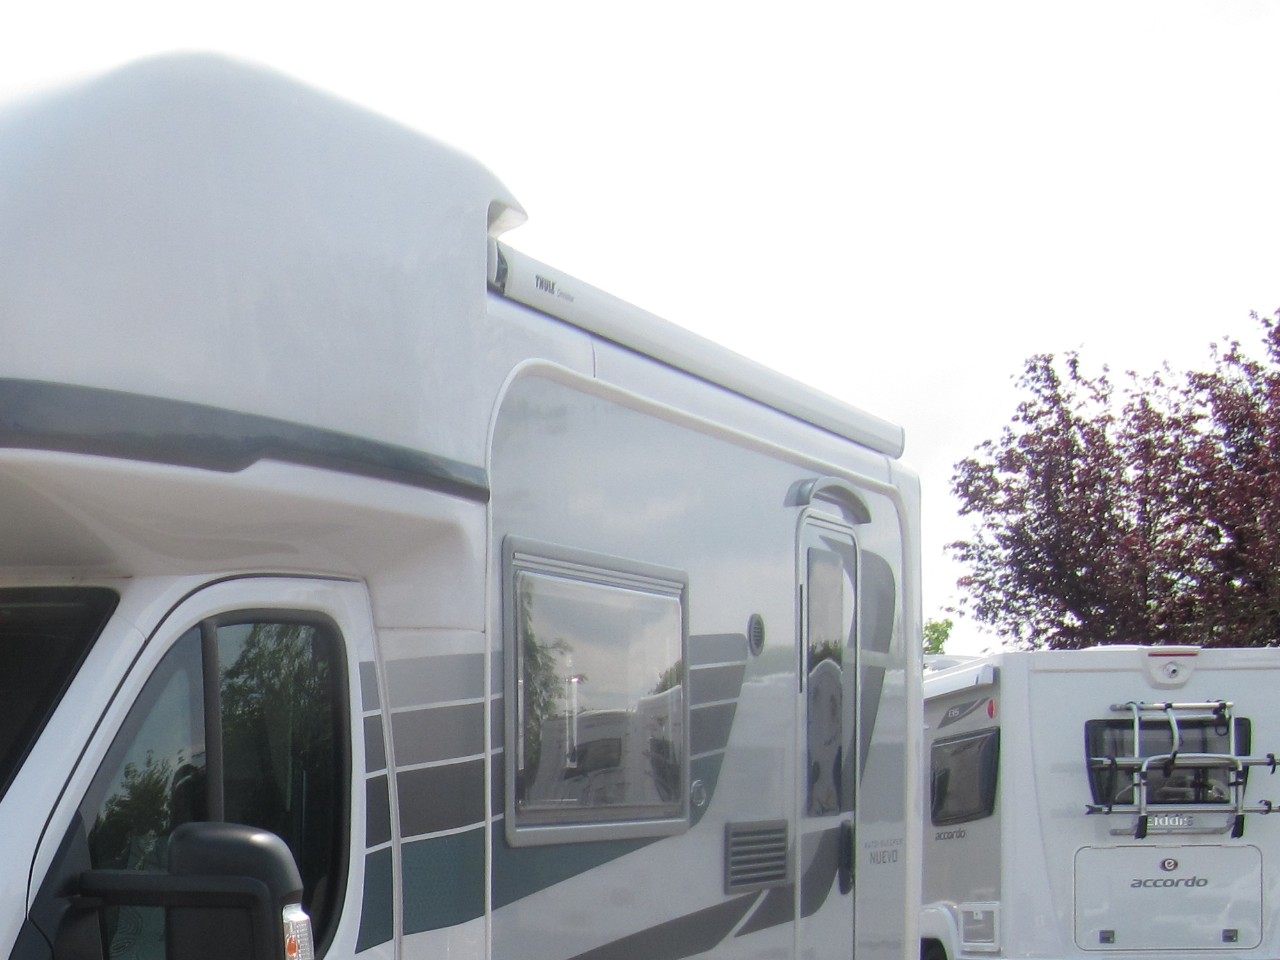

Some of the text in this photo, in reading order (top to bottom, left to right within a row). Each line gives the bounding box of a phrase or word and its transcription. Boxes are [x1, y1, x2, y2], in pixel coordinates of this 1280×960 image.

[934, 827, 966, 841] accordo
[869, 849, 898, 865] NUEVO
[1130, 875, 1209, 888] accordo
